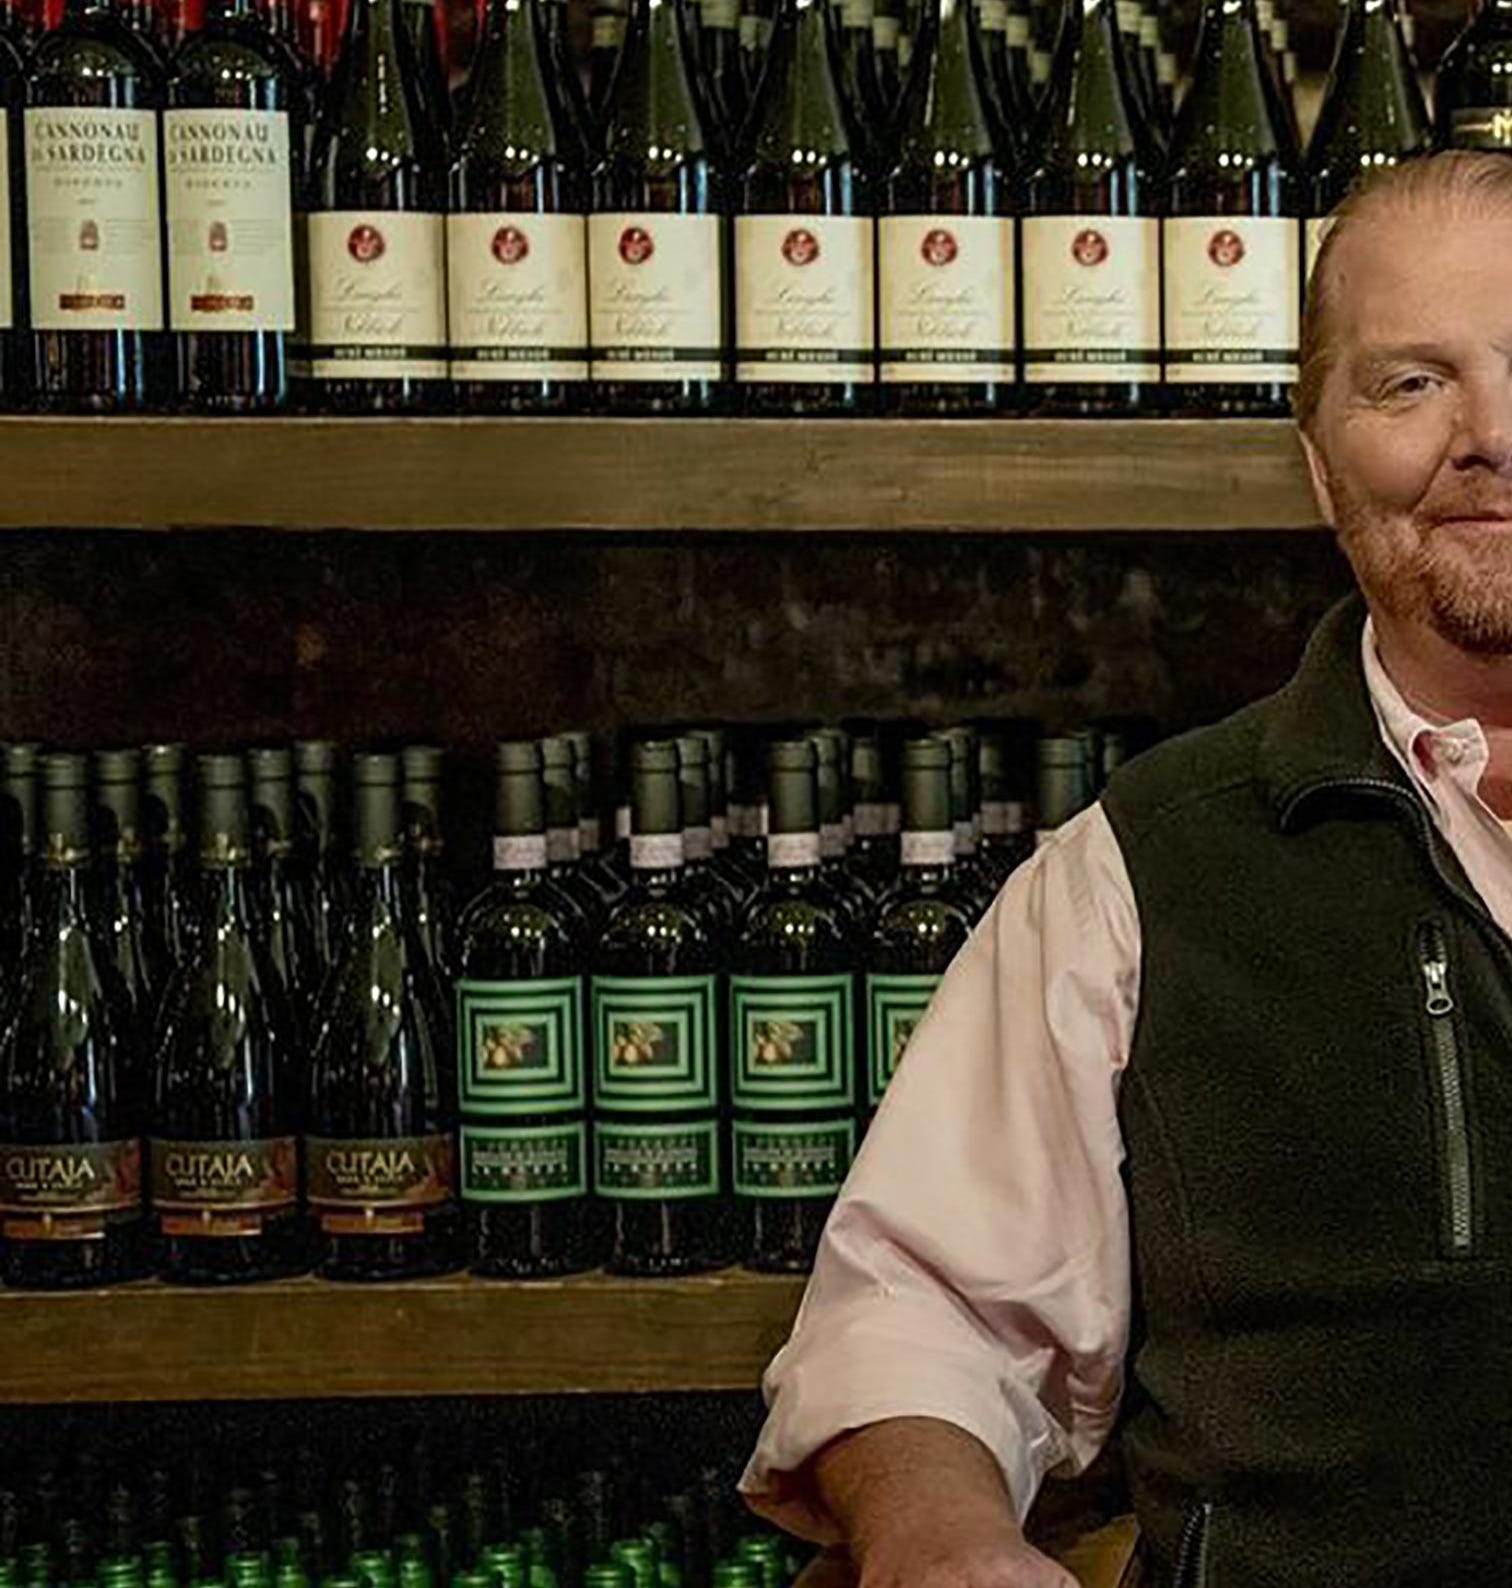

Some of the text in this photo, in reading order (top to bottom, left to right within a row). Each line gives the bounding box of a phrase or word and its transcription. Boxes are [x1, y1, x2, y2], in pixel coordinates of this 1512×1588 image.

[34, 121, 141, 142] CANNONAU
[169, 122, 270, 142] CANNONAU
[47, 144, 148, 166] SARDEGNA
[179, 145, 278, 166] SARDEGNA
[5, 1156, 95, 1187] CUTAJA
[165, 1153, 253, 1184] CUTAJA
[326, 1150, 416, 1180] CUTAJA
